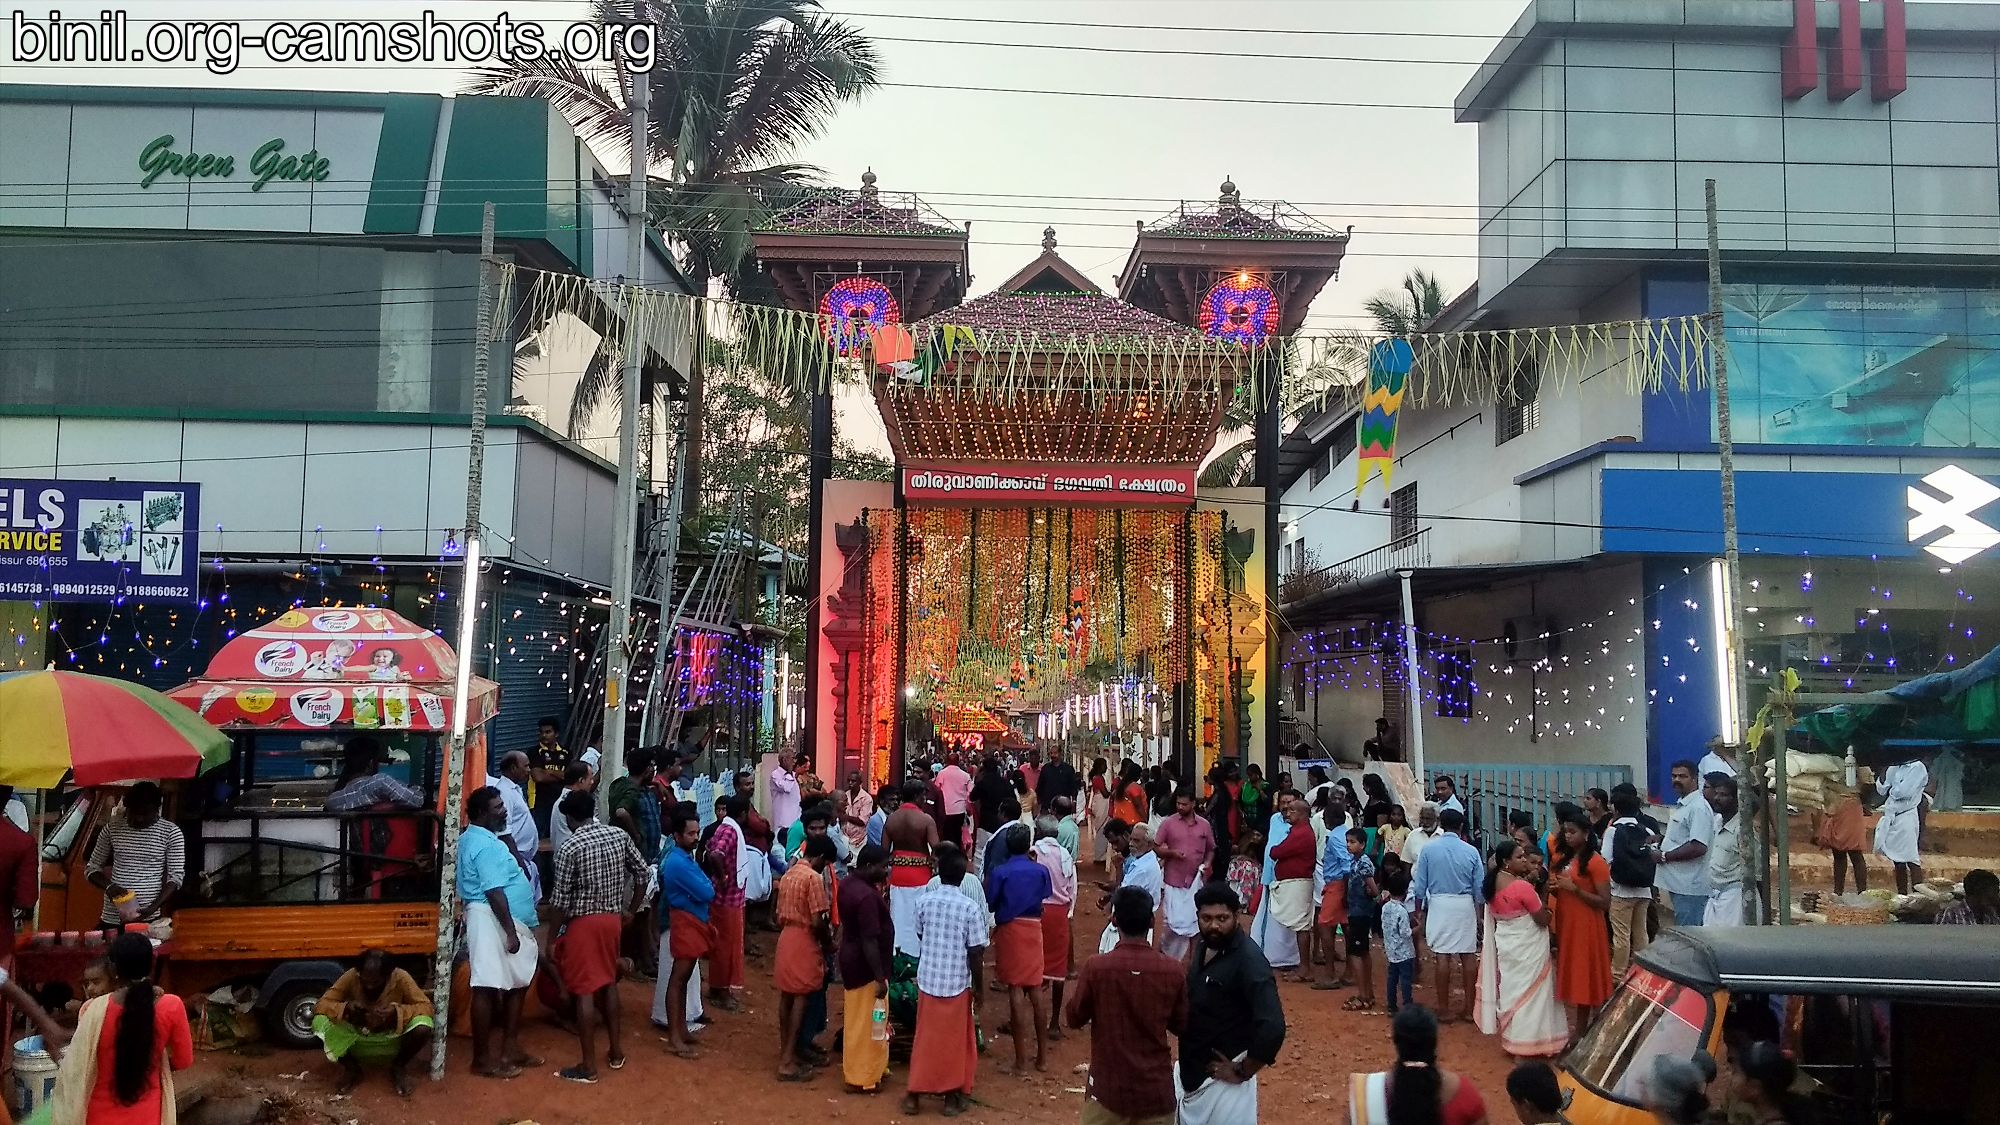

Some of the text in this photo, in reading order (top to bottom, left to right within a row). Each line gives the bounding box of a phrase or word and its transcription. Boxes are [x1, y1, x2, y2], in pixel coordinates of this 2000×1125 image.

[138, 134, 330, 192] Green Gate
[911, 471, 1187, 494] തിരുവാണിക്കാവ് ഭഗവതി ക്ഷേത്രം
[48, 556, 68, 567] 655
[53, 584, 116, 595] 9894012529
[126, 584, 189, 597] 9188660622
[270, 659, 294, 667] French
[307, 702, 331, 711] French
[311, 711, 331, 721] Dairy
